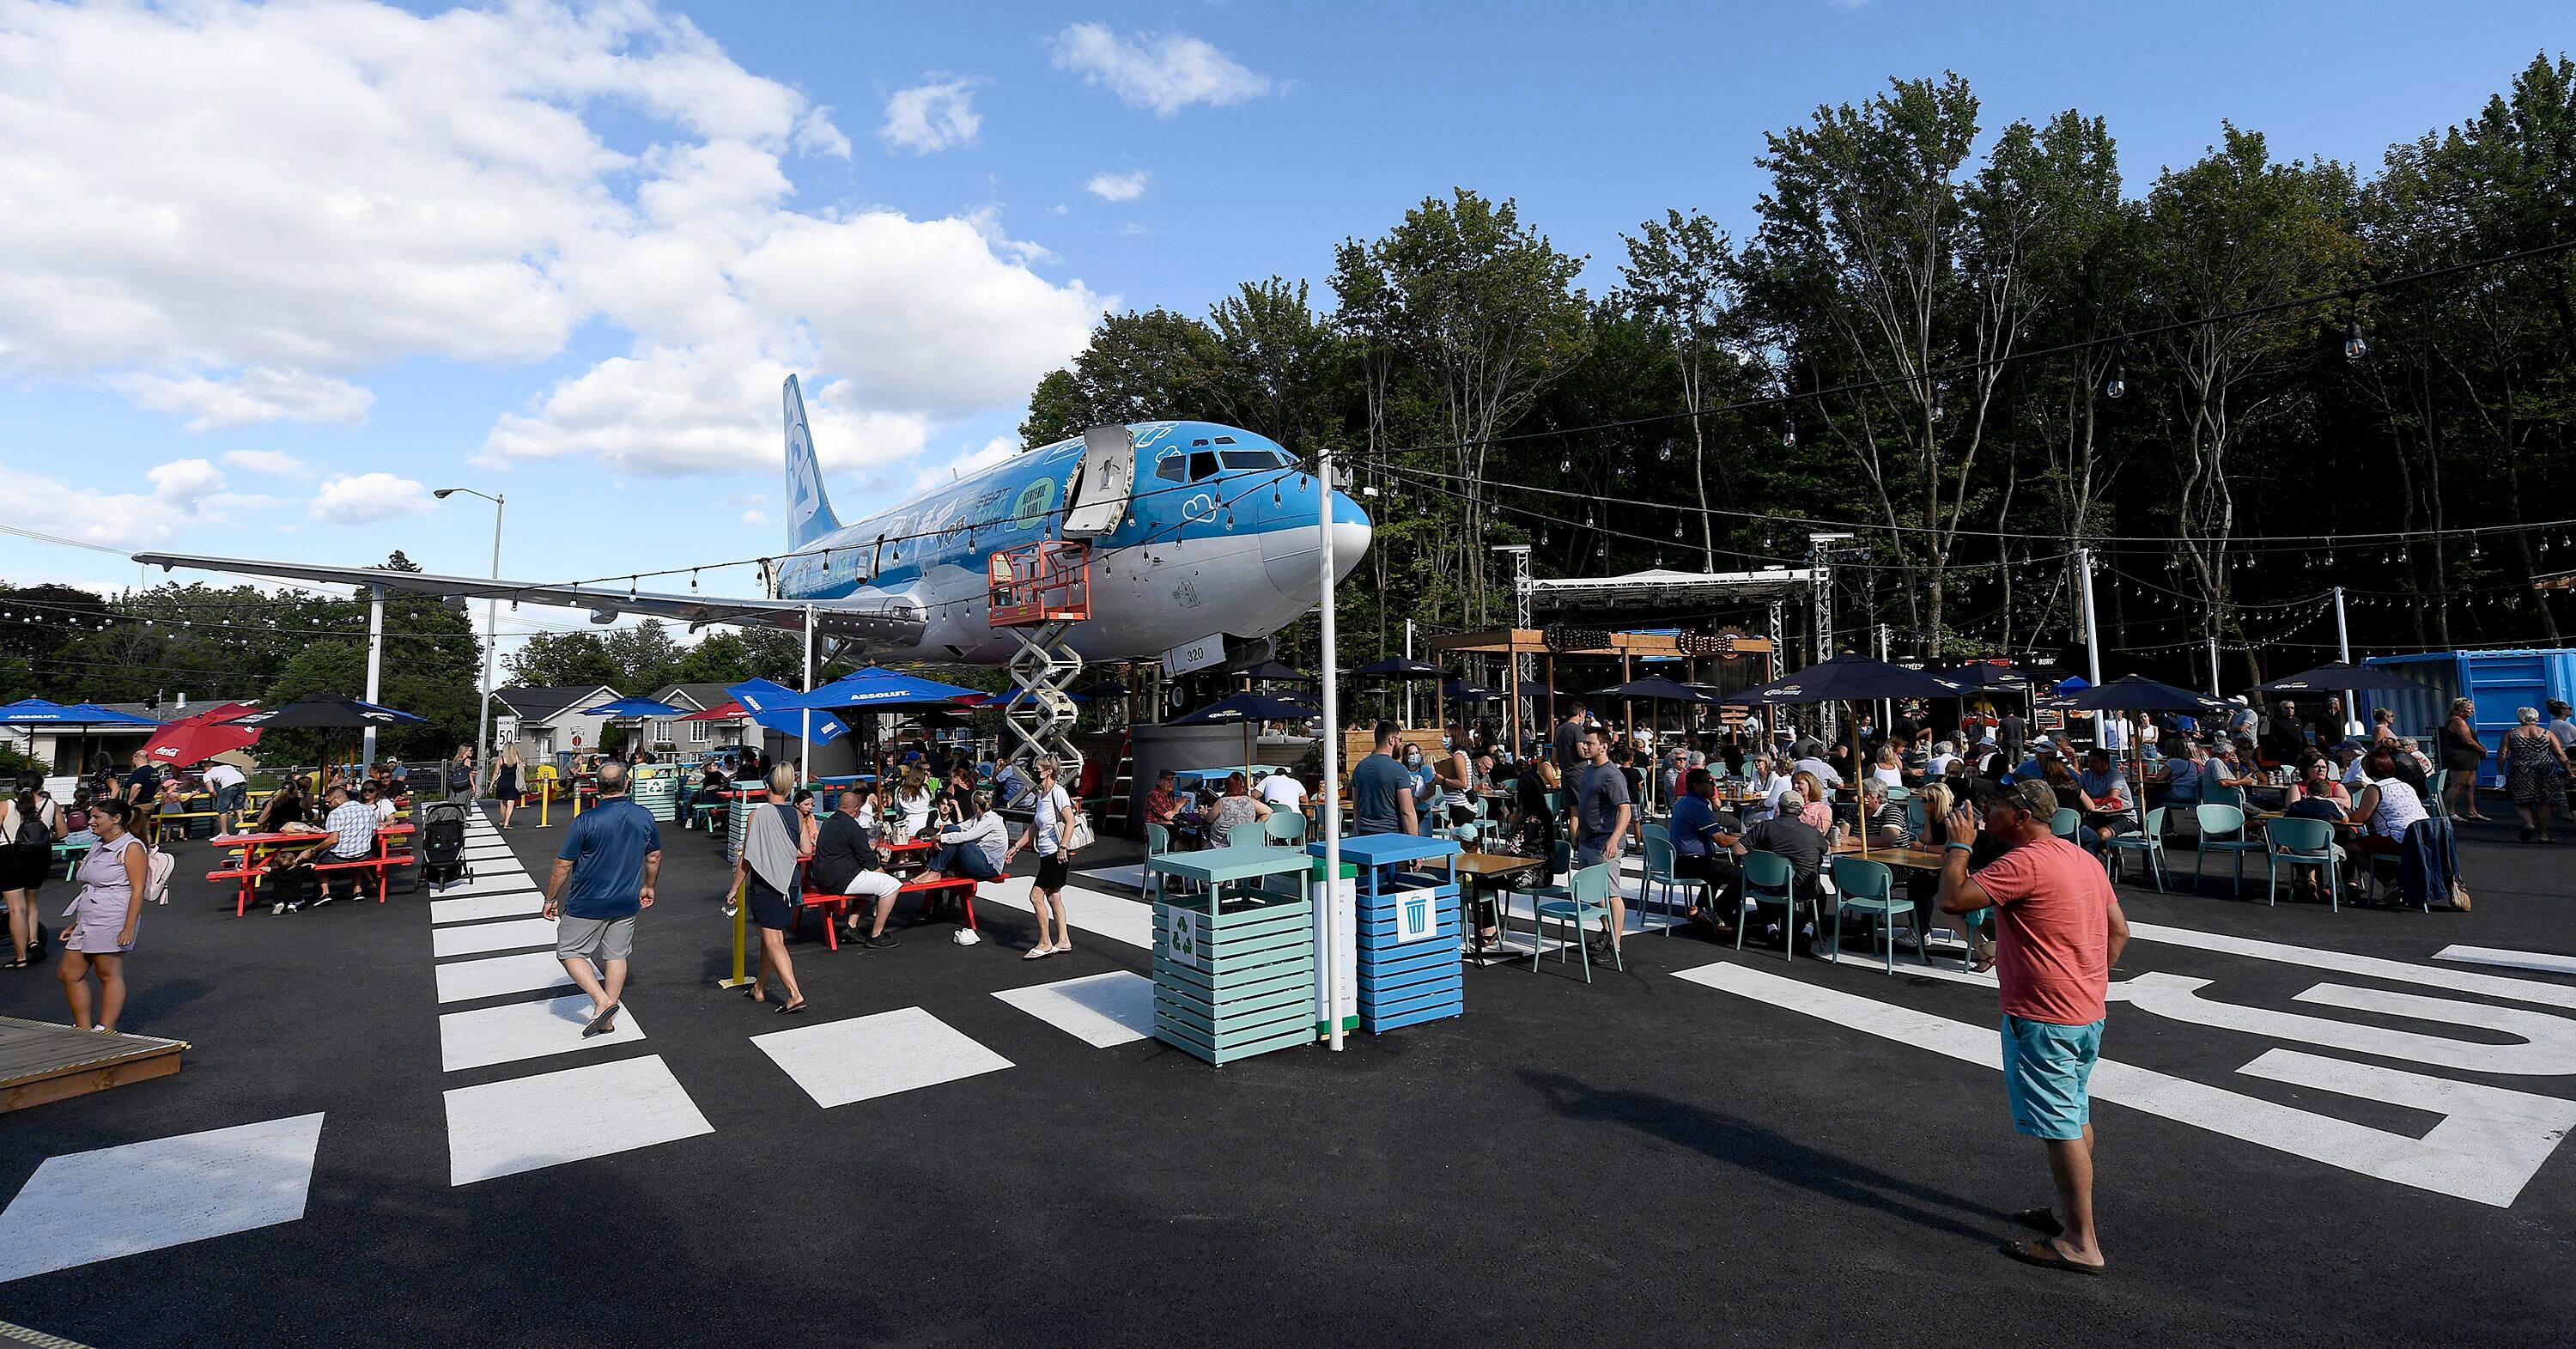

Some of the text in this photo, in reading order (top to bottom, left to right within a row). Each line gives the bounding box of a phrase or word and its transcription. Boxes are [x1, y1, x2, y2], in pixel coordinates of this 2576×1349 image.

[975, 487, 1012, 508] SEPT
[1188, 647, 1204, 663] 320
[499, 729, 513, 744] 50
